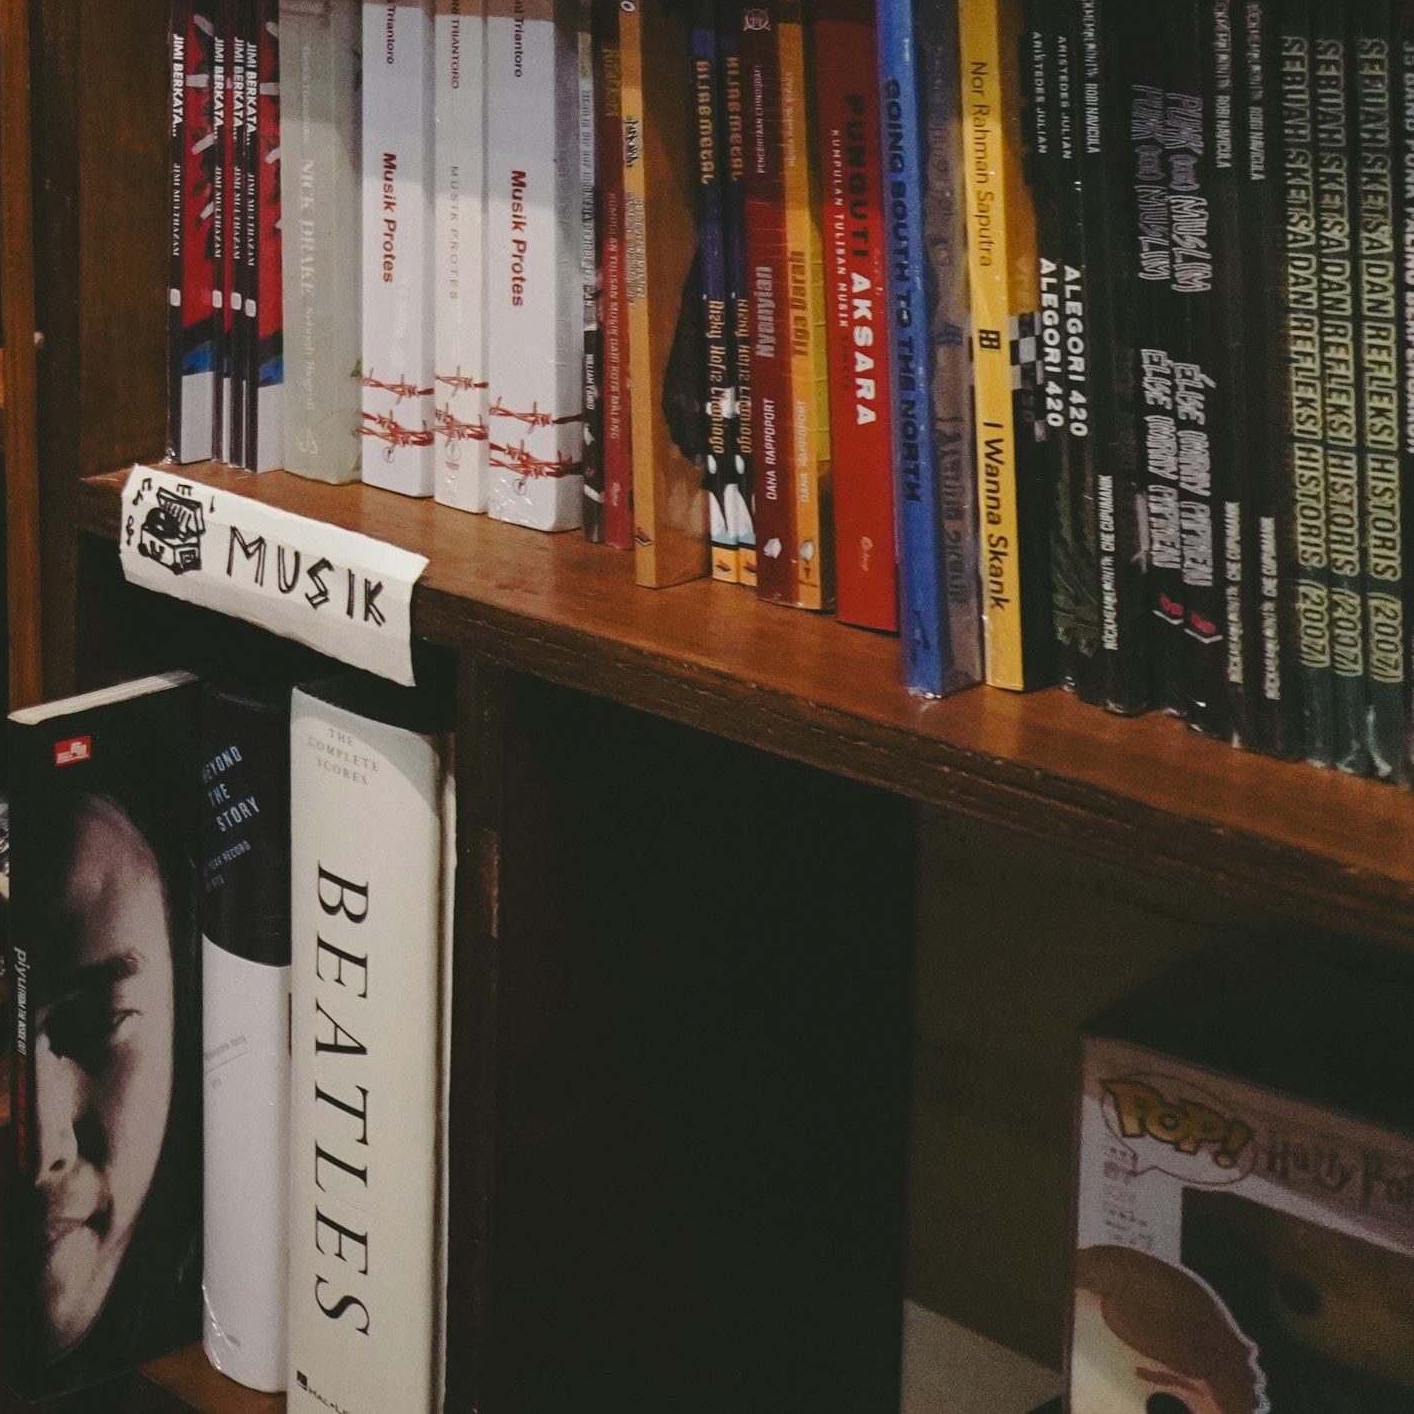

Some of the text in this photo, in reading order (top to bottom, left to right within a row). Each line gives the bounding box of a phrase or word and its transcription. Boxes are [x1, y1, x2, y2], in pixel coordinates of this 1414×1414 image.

[172, 32, 185, 138] JIMI BERKATA...
[971, 61, 996, 268] Nor Rahman Saputra
[299, 218, 316, 298] DRAKE
[510, 169, 528, 308] Musik Protes
[830, 129, 849, 328] KUMPULAN TULISAN MUSIK
[1168, 193, 1212, 294] MUSLIM
[851, 272, 876, 427] AKSARA
[1038, 258, 1064, 428] ALEGORI 420
[1357, 37, 1405, 684] SEBUAH SKETSA DAN REFLEKSI HISTORIS (2007)
[763, 397, 778, 501] DANA RAPPOPORT
[902, 397, 922, 503] NORTH
[225, 524, 388, 628] MUSIK
[983, 442, 1010, 611] Wanna Skank
[201, 744, 243, 784] BEYOND
[308, 736, 380, 773] COMPLETE
[316, 758, 369, 786] SCORES
[328, 727, 354, 748] THE
[207, 783, 231, 808] THE
[216, 795, 261, 833] STORY
[314, 858, 370, 1338] BEATLES
[1100, 1078, 1255, 1171] POP!
